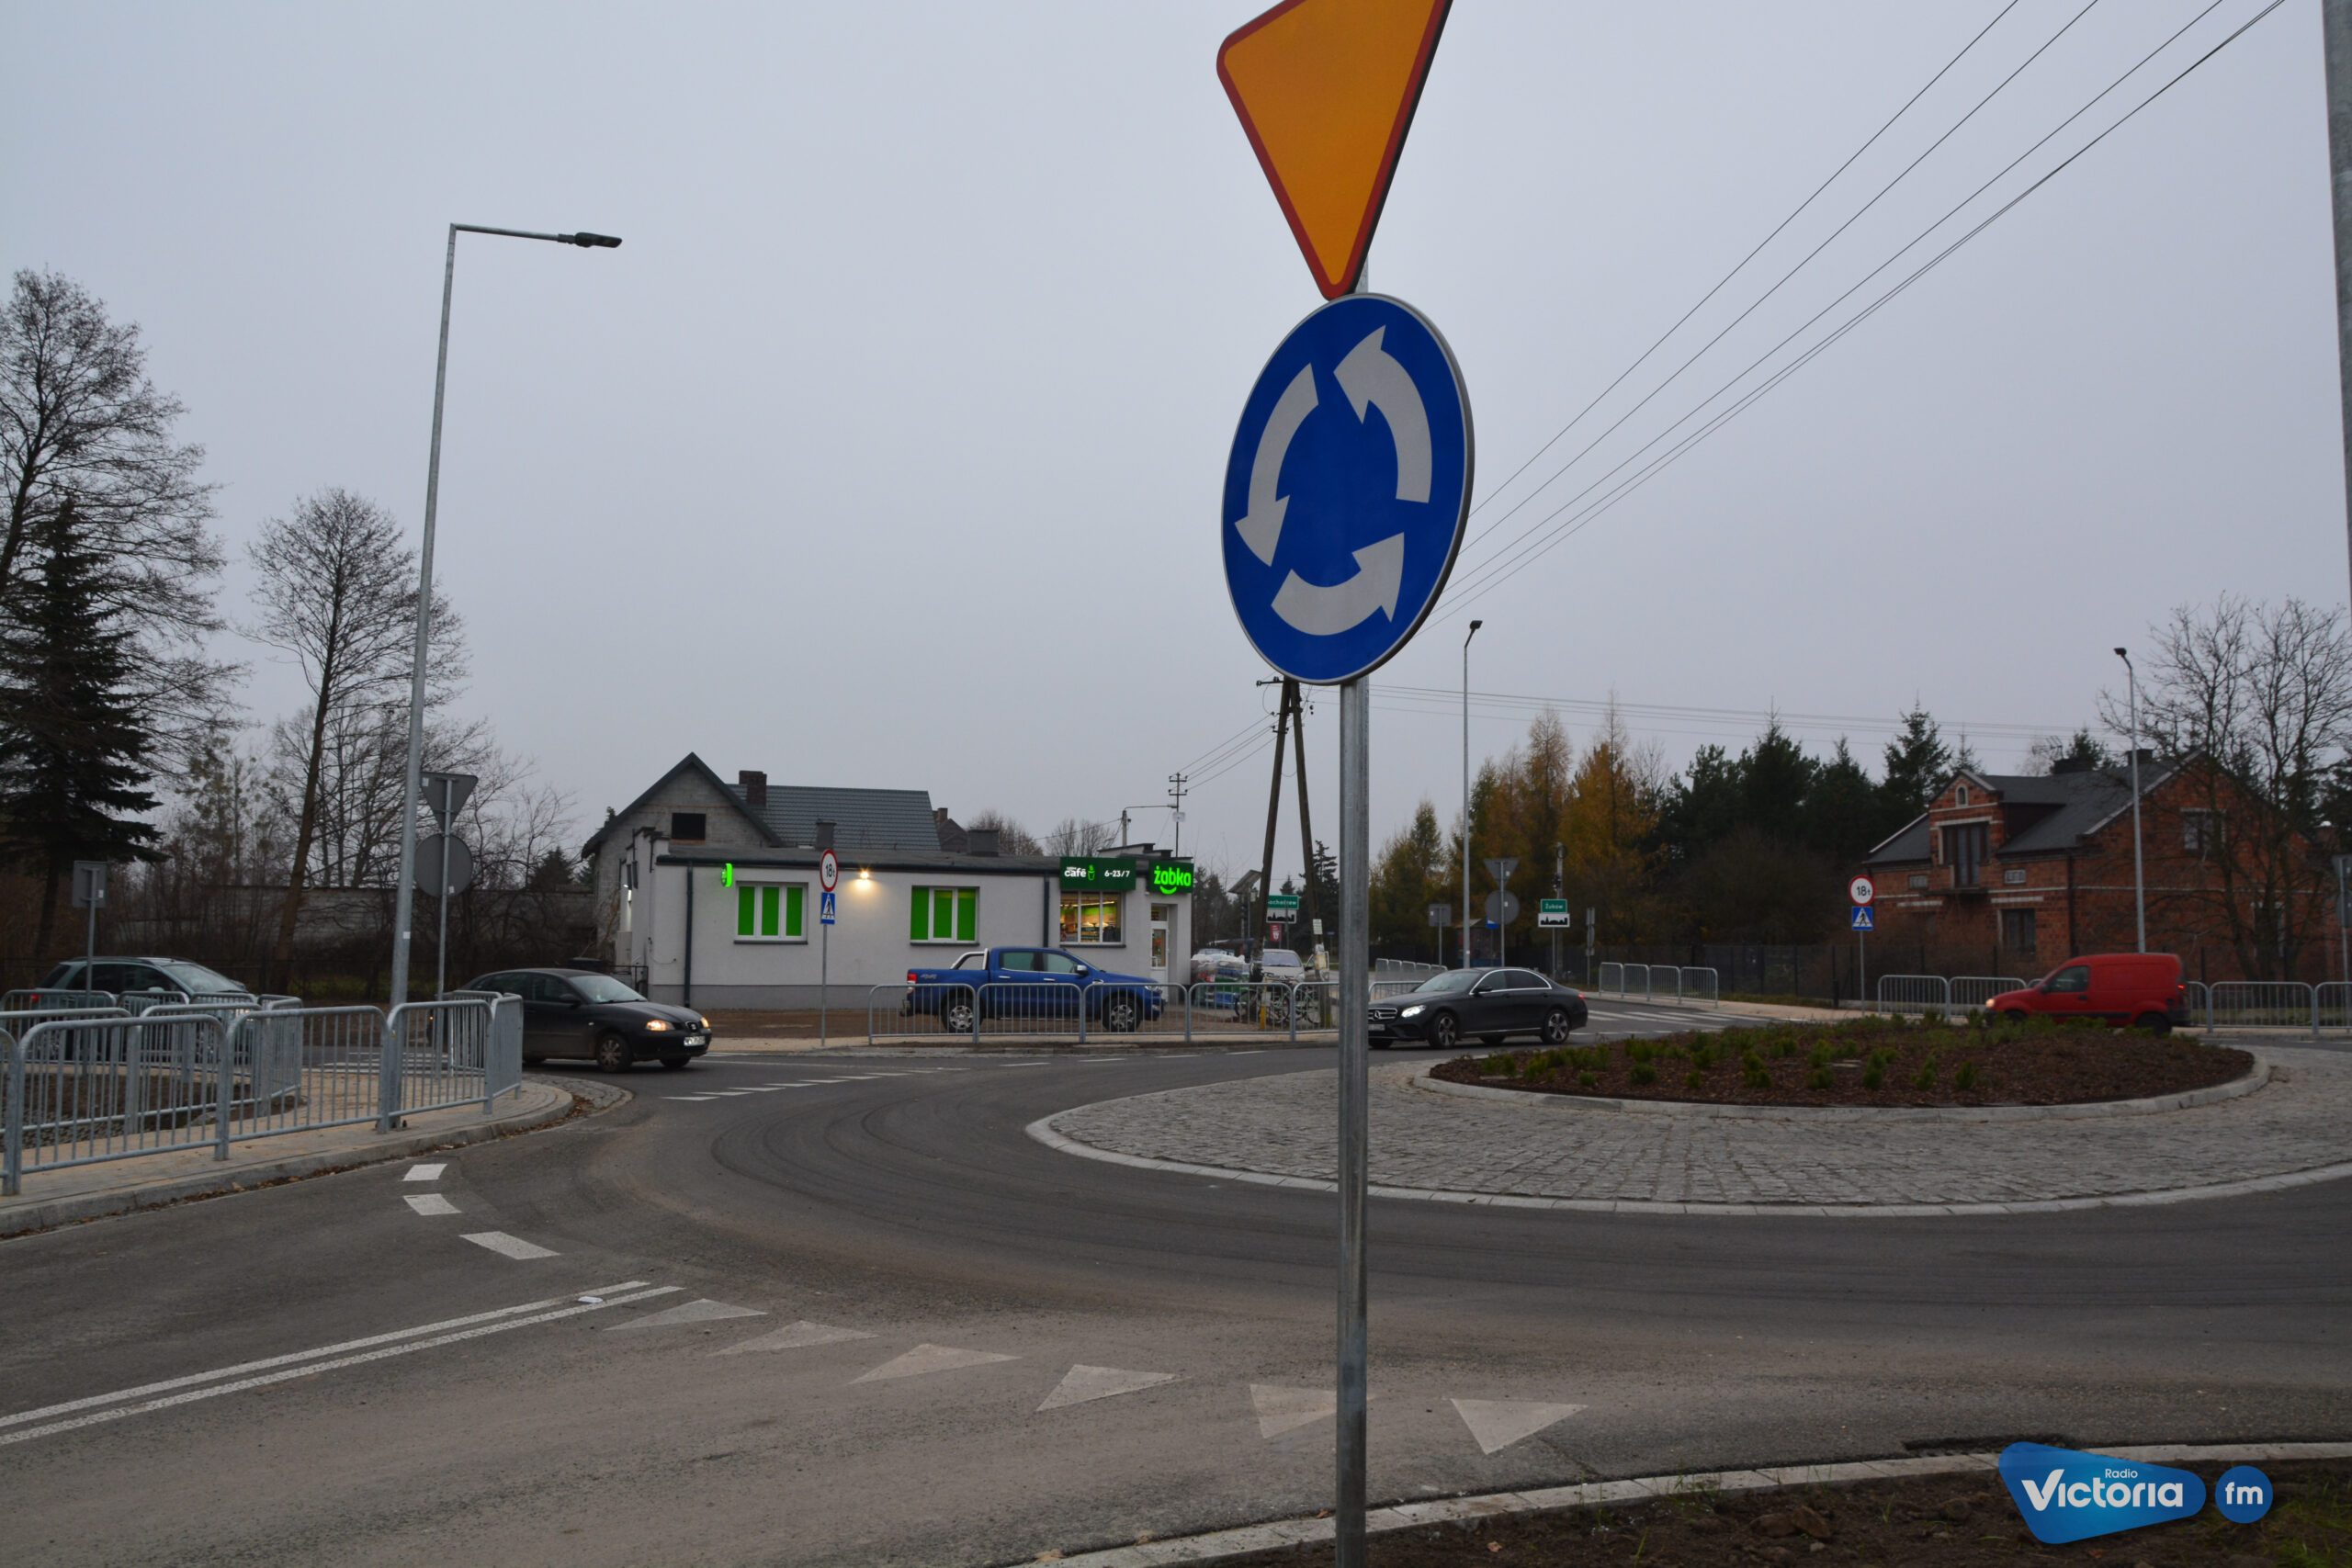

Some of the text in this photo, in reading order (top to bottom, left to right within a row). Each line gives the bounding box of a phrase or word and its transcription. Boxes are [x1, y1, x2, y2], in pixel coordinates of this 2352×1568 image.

[1064, 868, 1130, 878] café 6-23/7
[1153, 864, 1192, 887] żabka
